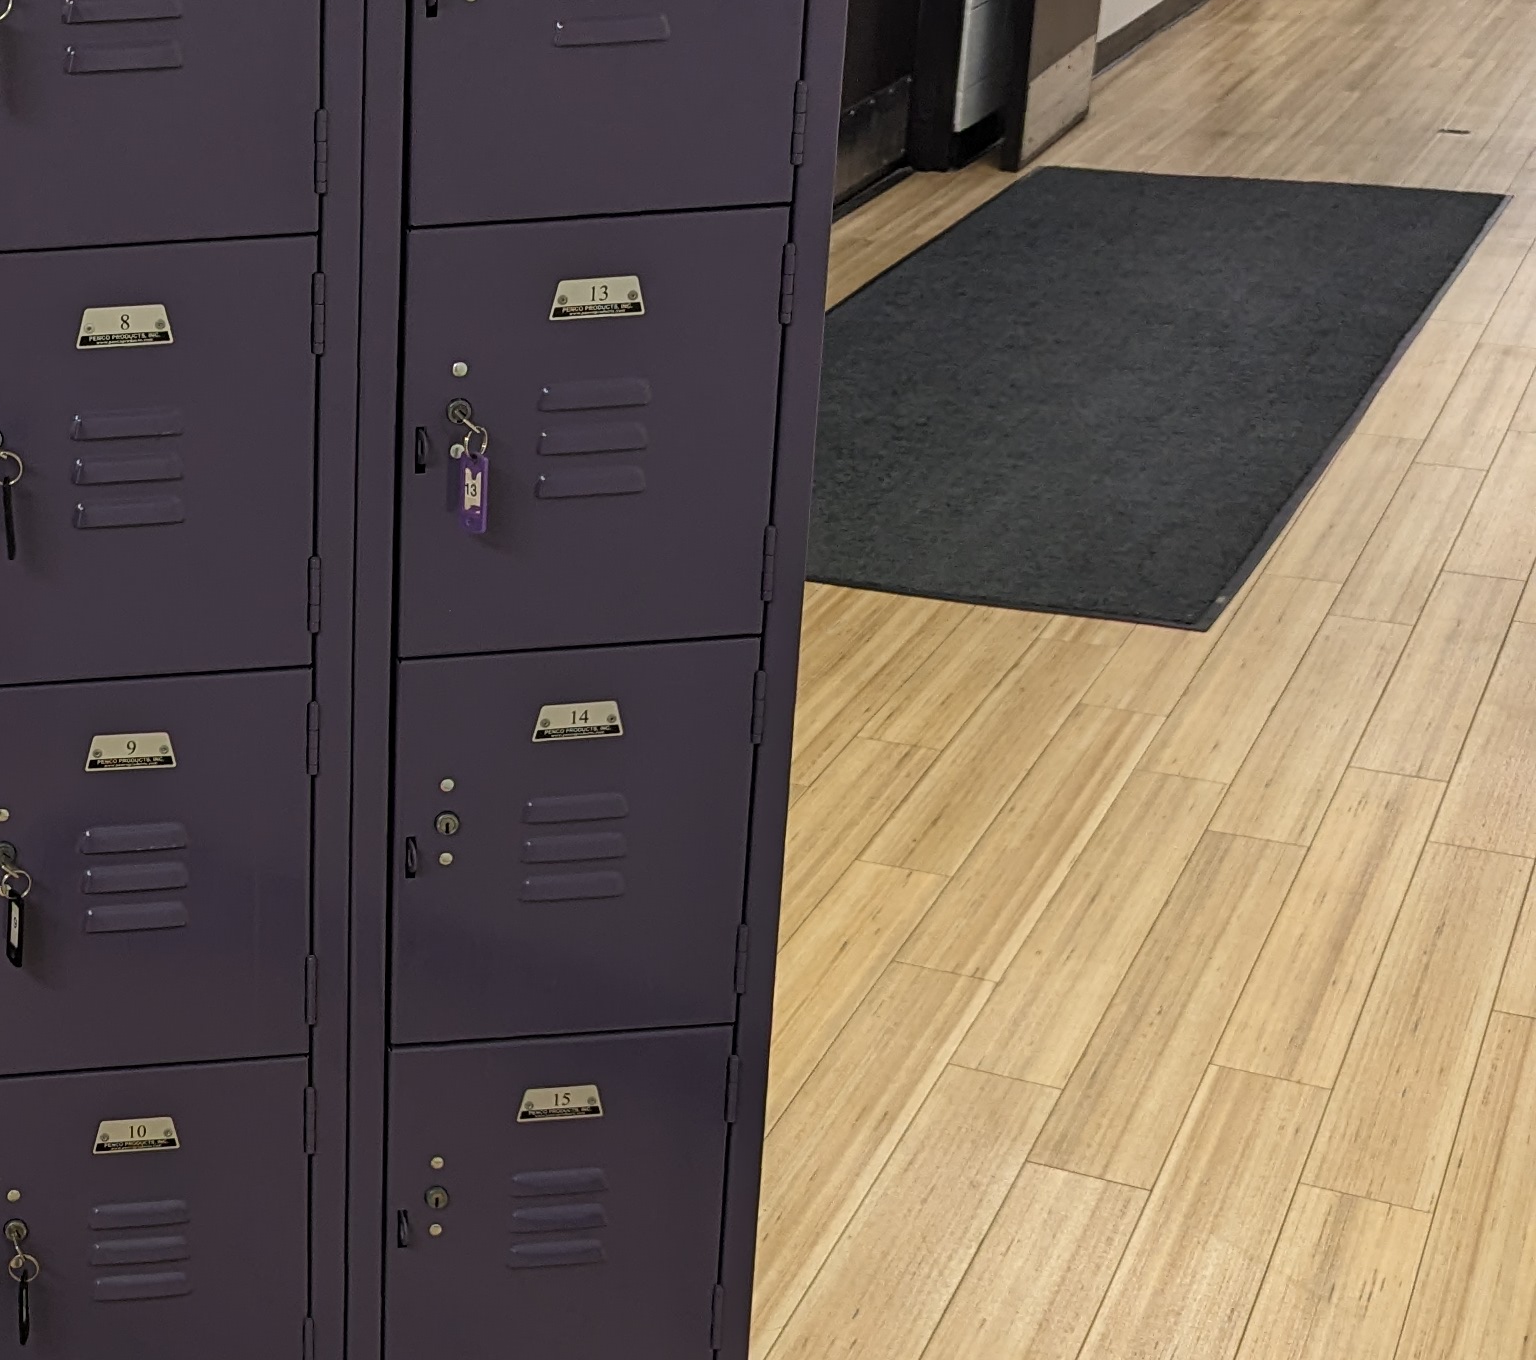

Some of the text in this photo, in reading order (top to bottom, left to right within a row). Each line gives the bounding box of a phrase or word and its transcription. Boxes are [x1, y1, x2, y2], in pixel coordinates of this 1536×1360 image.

[591, 285, 608, 302] 13
[120, 314, 130, 330] 8
[464, 483, 477, 497] 13
[571, 710, 589, 724] 14
[126, 740, 136, 755] 9
[554, 1092, 571, 1106] 15
[129, 1125, 146, 1138] 10
